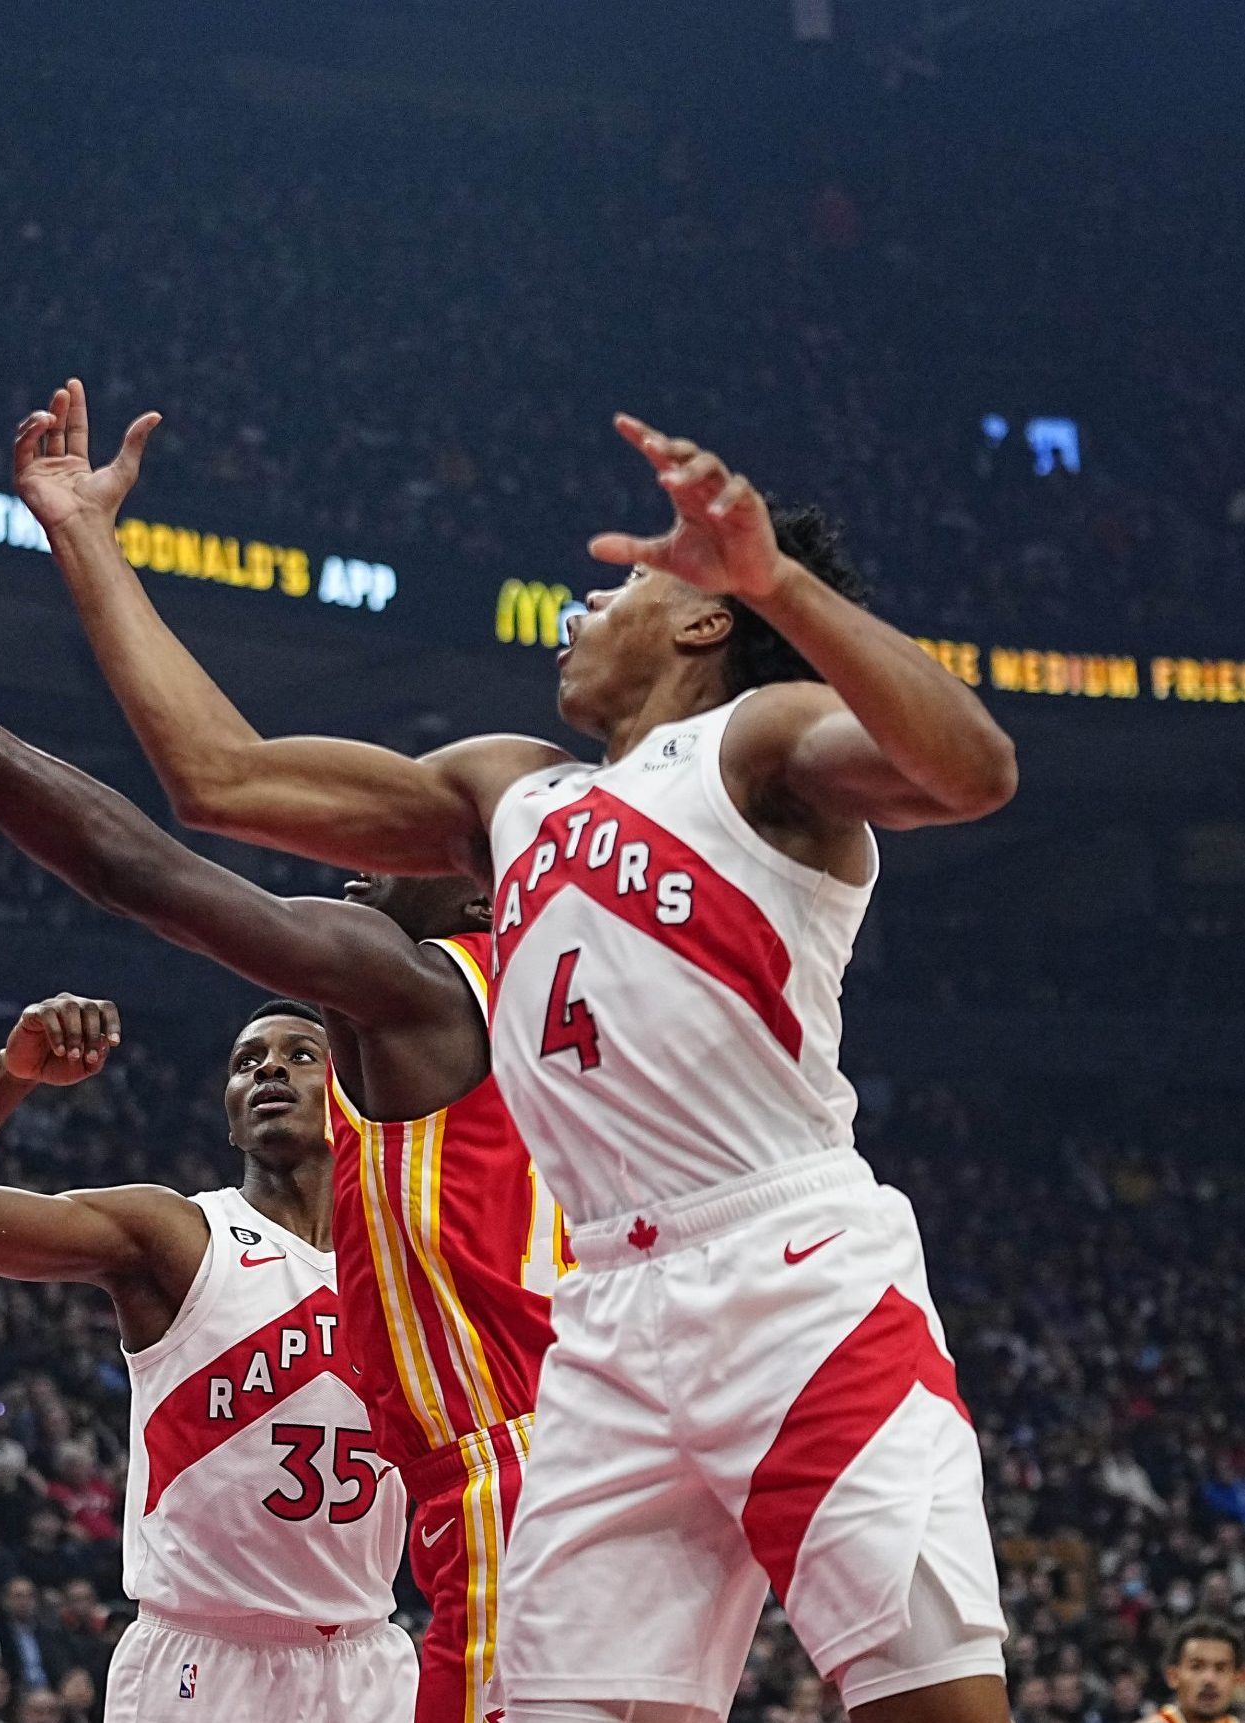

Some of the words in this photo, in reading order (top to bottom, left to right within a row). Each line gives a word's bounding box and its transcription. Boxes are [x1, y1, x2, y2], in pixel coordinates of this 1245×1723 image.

[115, 518, 310, 597] DONALD'S
[318, 555, 397, 612] APP
[990, 646, 1139, 698] MEDIUM
[1151, 655, 1245, 704] FRIE
[540, 947, 602, 1072] 4
[235, 1229, 256, 1244] 6
[209, 1315, 339, 1421] RAPT
[262, 1423, 378, 1525] 35
